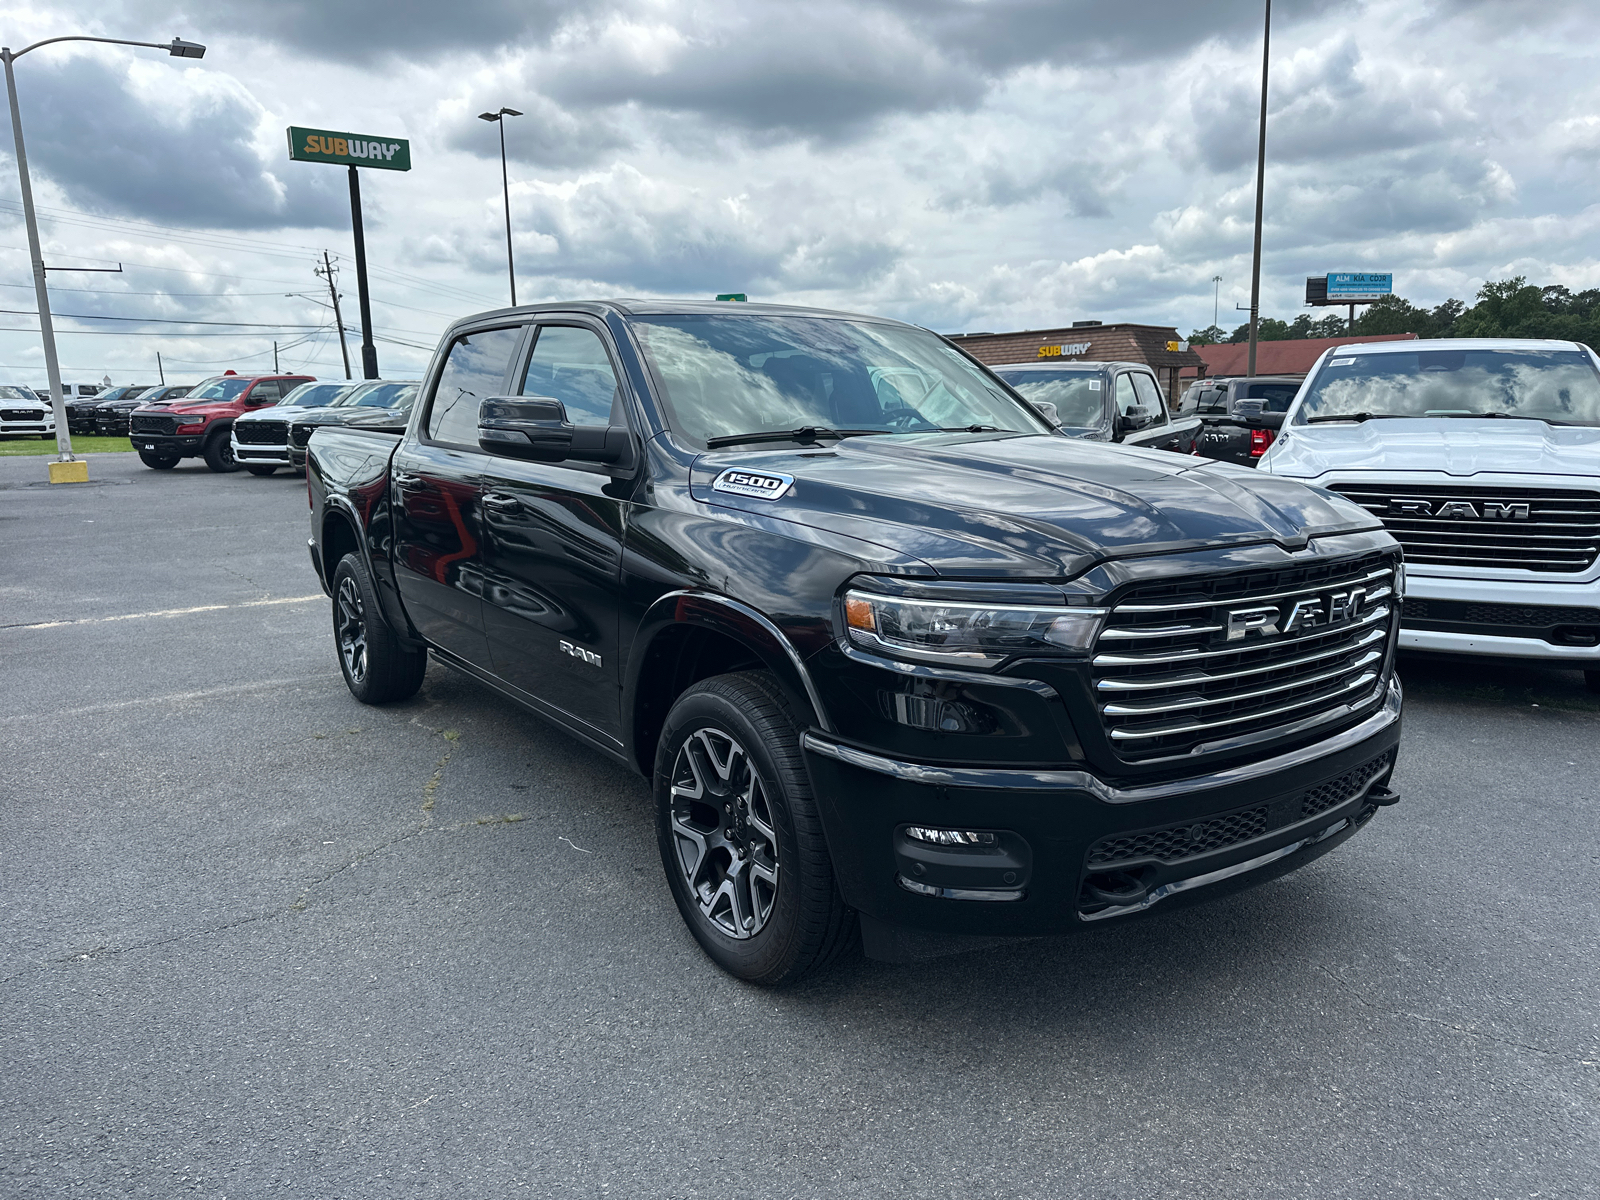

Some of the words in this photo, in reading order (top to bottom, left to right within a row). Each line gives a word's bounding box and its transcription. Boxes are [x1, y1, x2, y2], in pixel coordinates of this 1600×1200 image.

[303, 135, 401, 160] SUBWAY
[1037, 342, 1092, 357] SUBWAY
[728, 473, 780, 489] 1500
[1389, 499, 1530, 519] RAM
[1226, 587, 1367, 641] RAM
[559, 639, 602, 668] RAM
